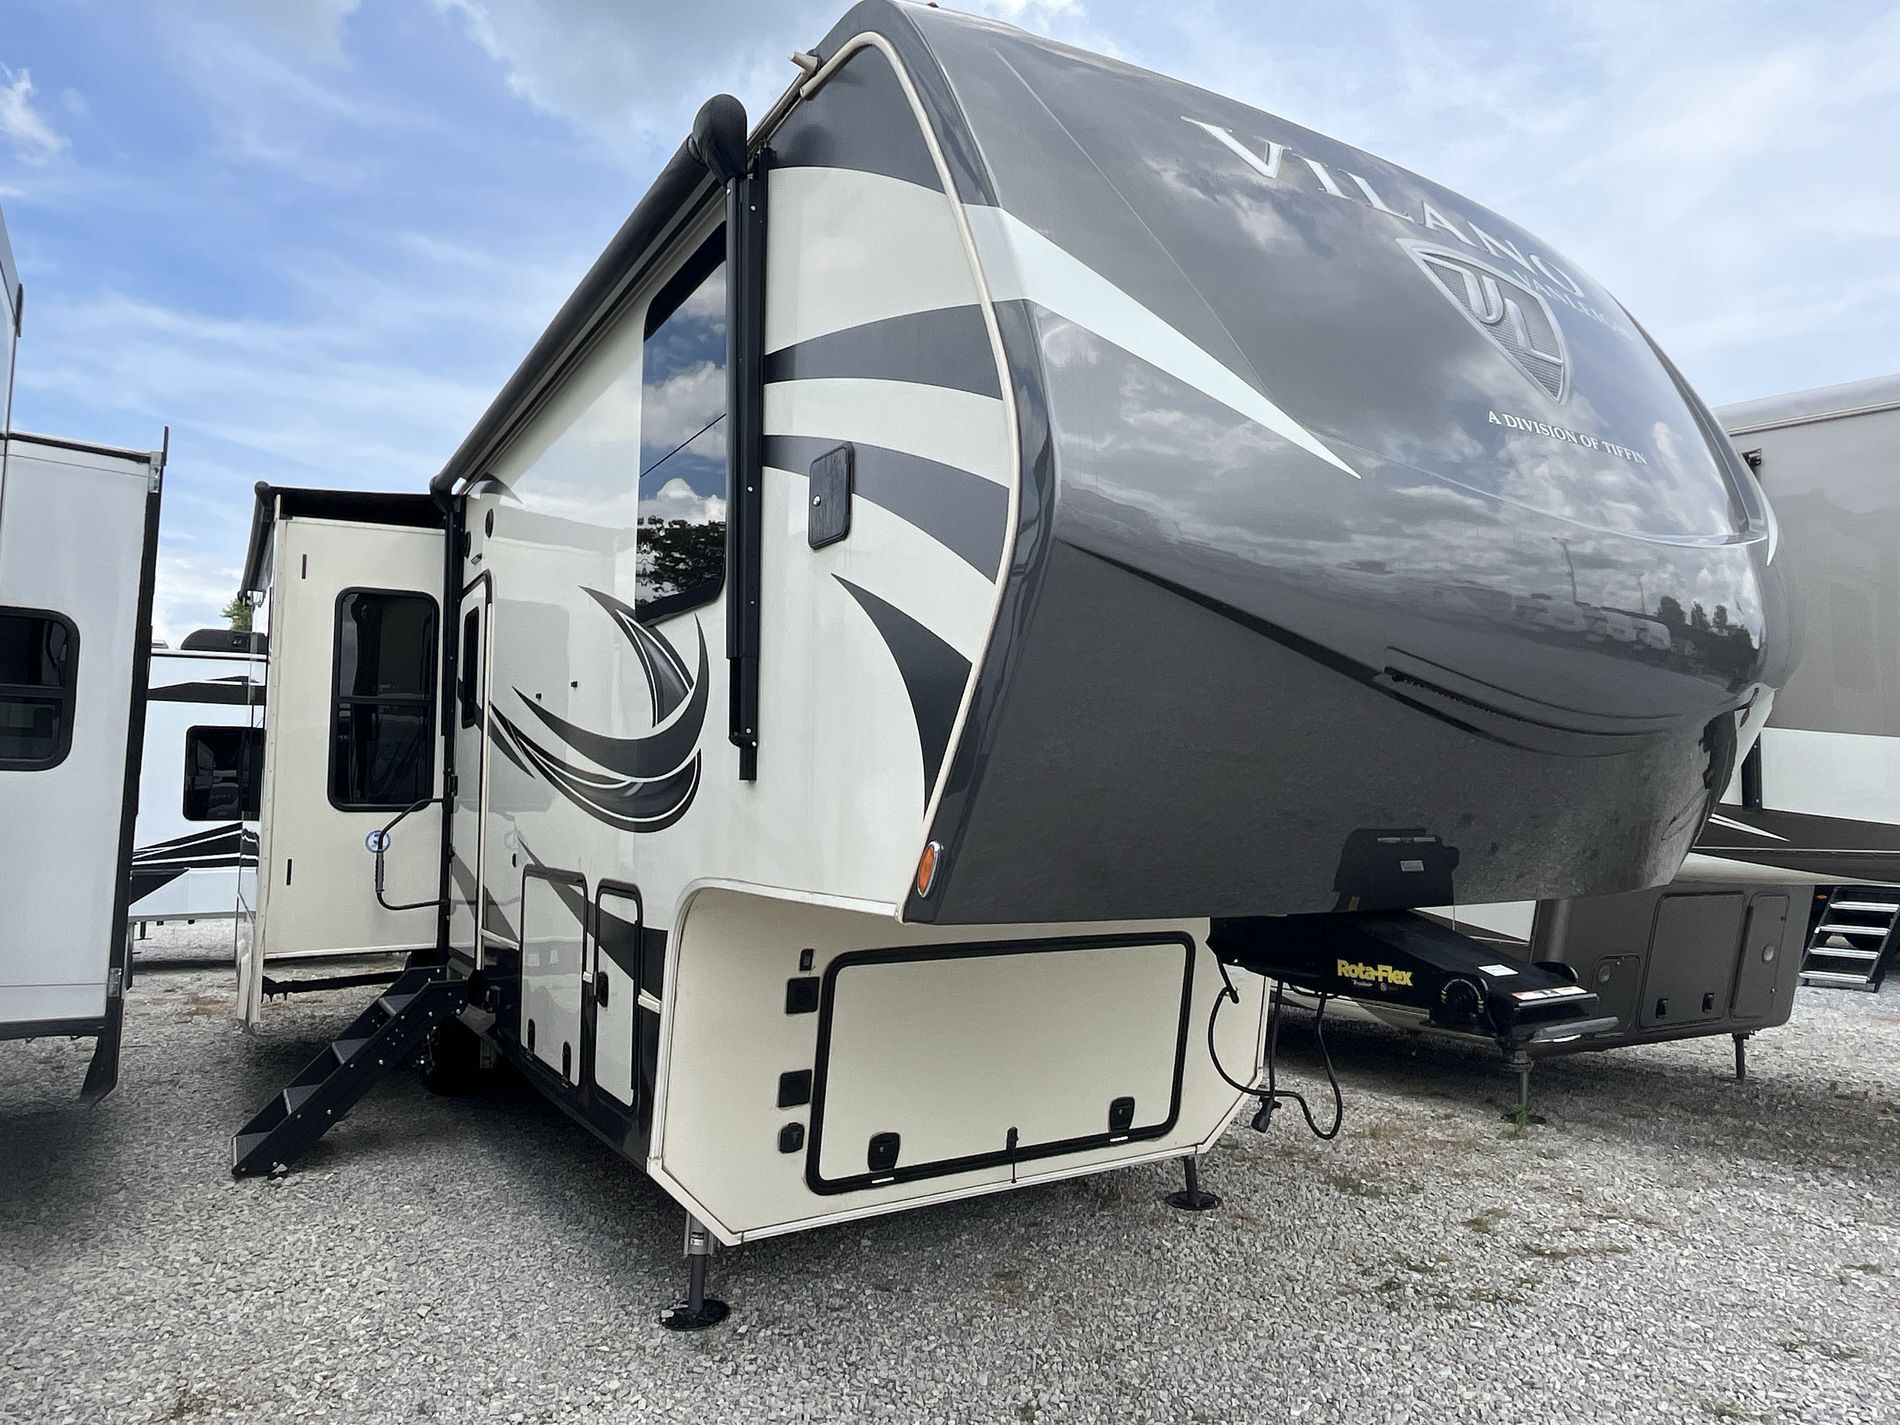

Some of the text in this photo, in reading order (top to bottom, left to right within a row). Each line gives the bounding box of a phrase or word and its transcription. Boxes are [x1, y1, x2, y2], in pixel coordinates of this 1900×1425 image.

[1180, 115, 1585, 298] VILANO
[1488, 410, 1648, 465] A DIVISION OF TIFFIN
